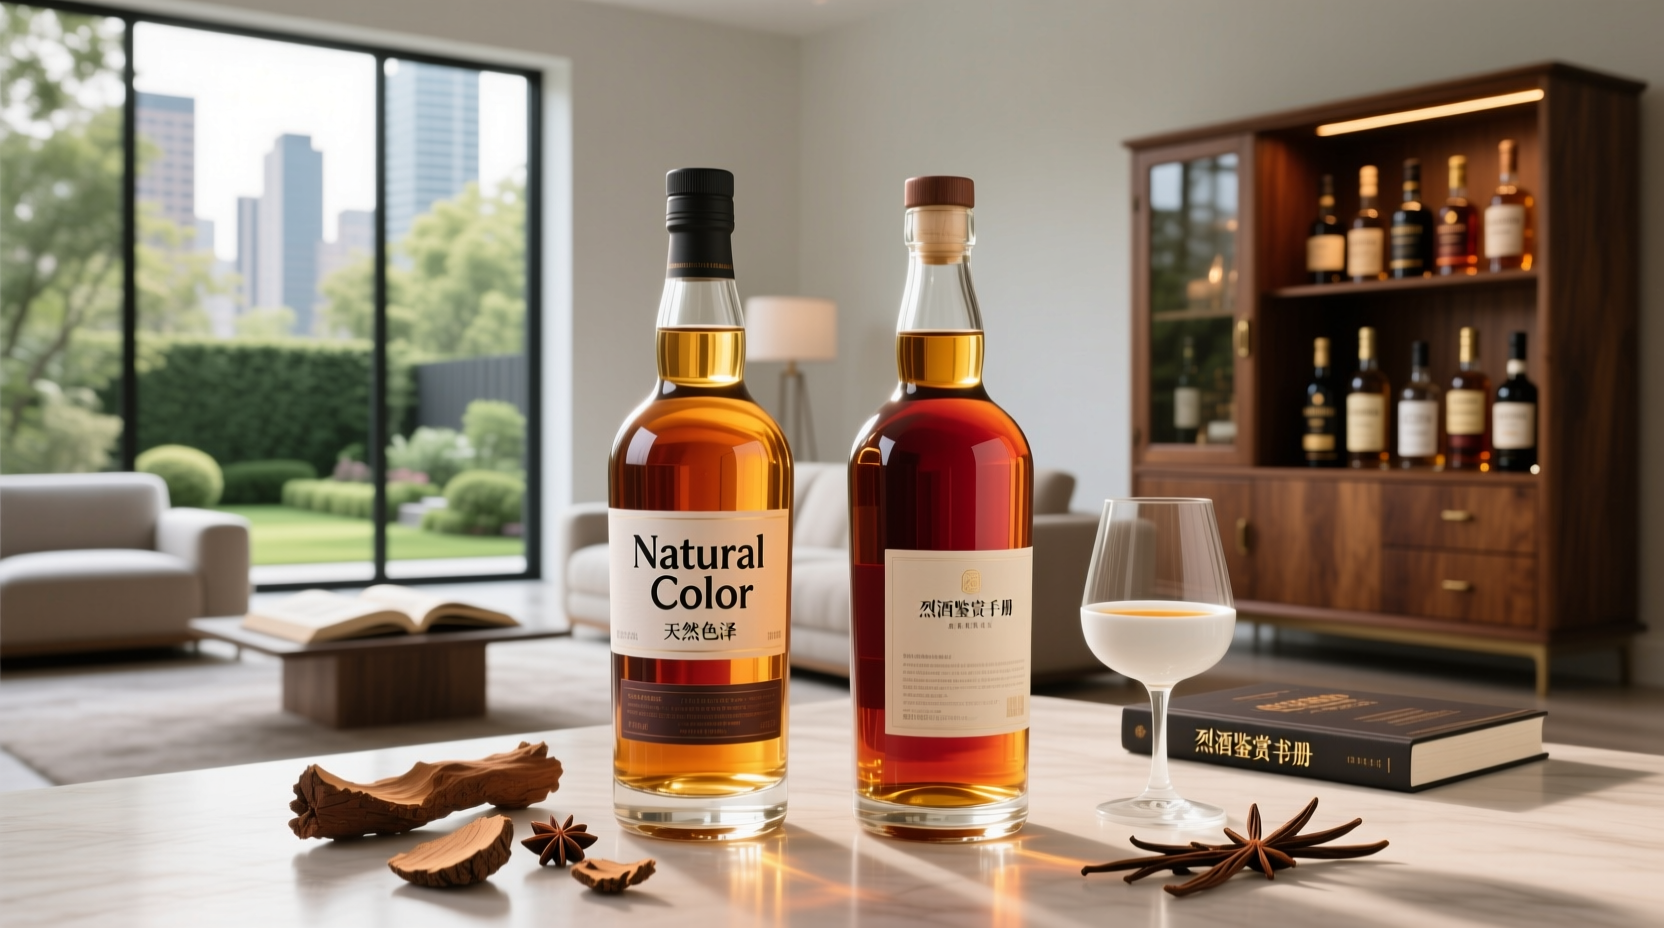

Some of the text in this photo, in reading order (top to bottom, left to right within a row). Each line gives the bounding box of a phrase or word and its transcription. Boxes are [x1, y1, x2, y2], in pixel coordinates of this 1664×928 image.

[633, 533, 764, 570] Natural
[651, 575, 754, 610] Color
[663, 621, 737, 642] 天然色泽
[1194, 727, 1314, 768] 烈酒鉴赏书册
